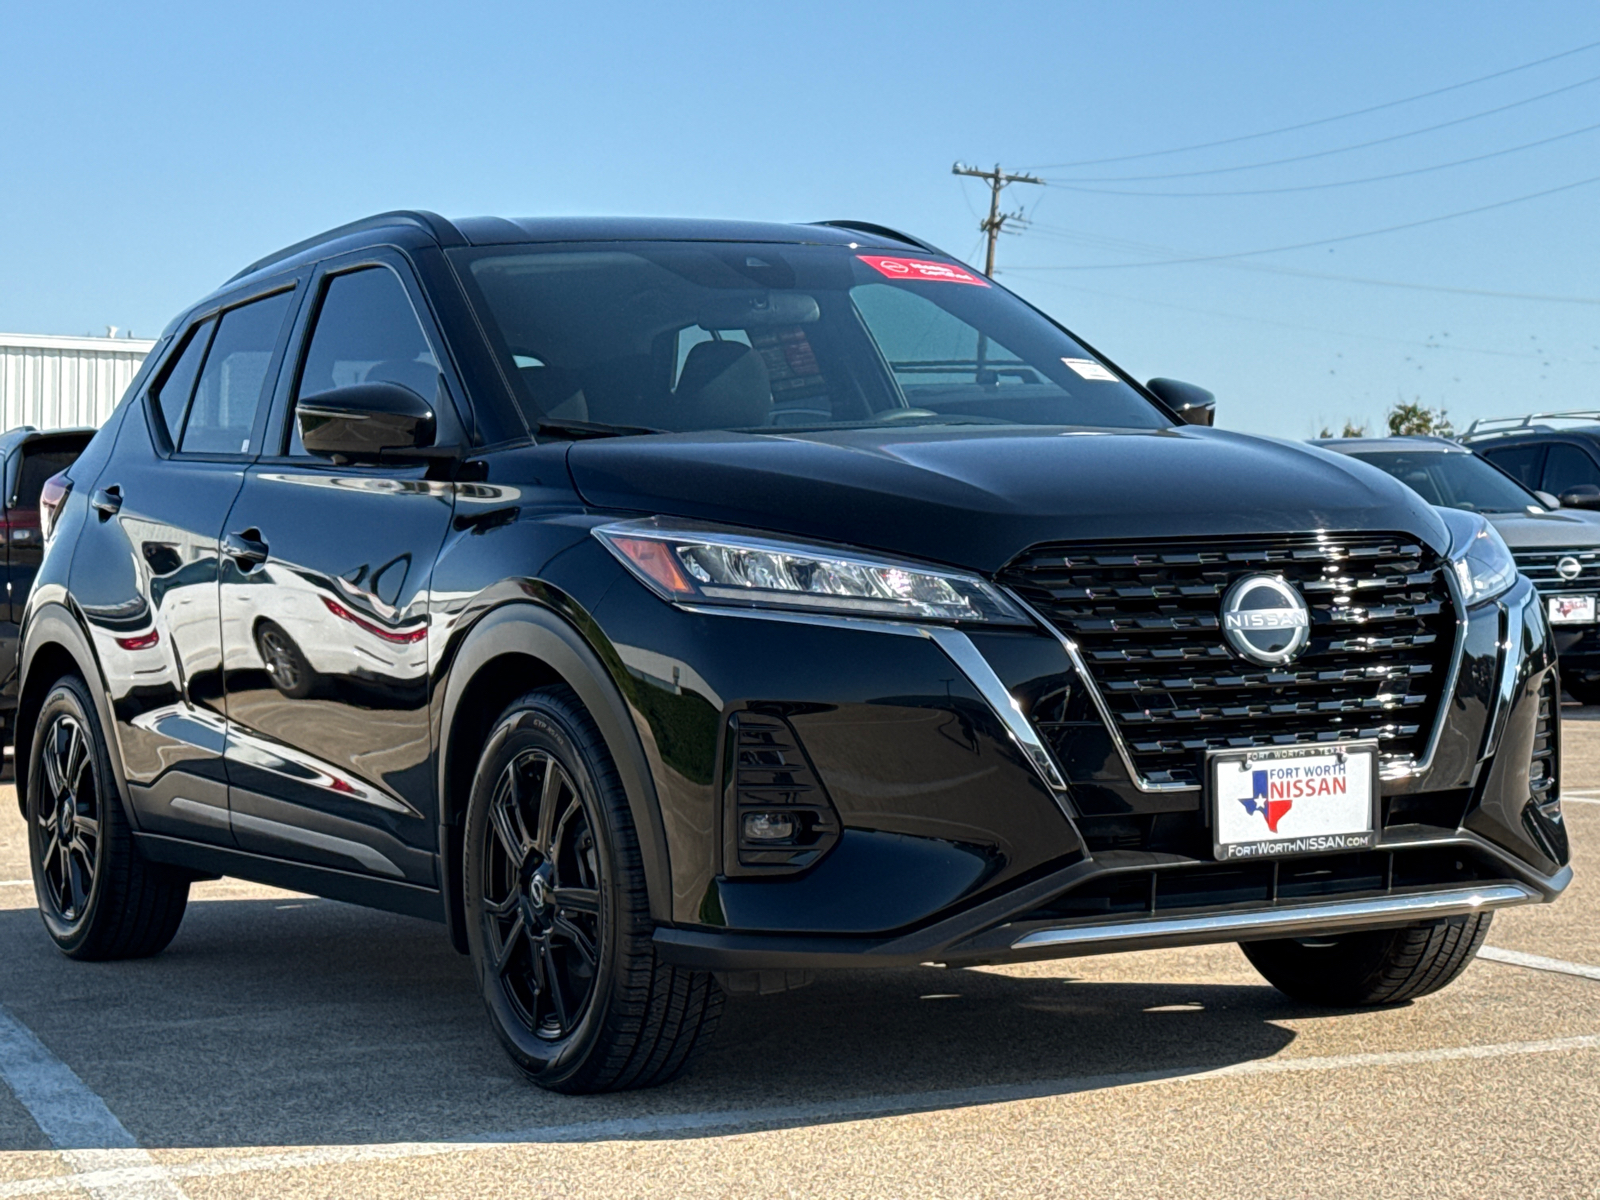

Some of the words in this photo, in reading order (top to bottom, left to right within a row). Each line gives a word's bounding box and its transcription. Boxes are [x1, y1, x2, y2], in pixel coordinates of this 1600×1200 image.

[1226, 612, 1306, 628] NISSAN
[1246, 752, 1270, 761] FORT
[1273, 749, 1305, 760] WORTH
[1269, 767, 1300, 780] FORT
[1303, 763, 1346, 777] WORTH
[1270, 776, 1347, 799] NISSAN
